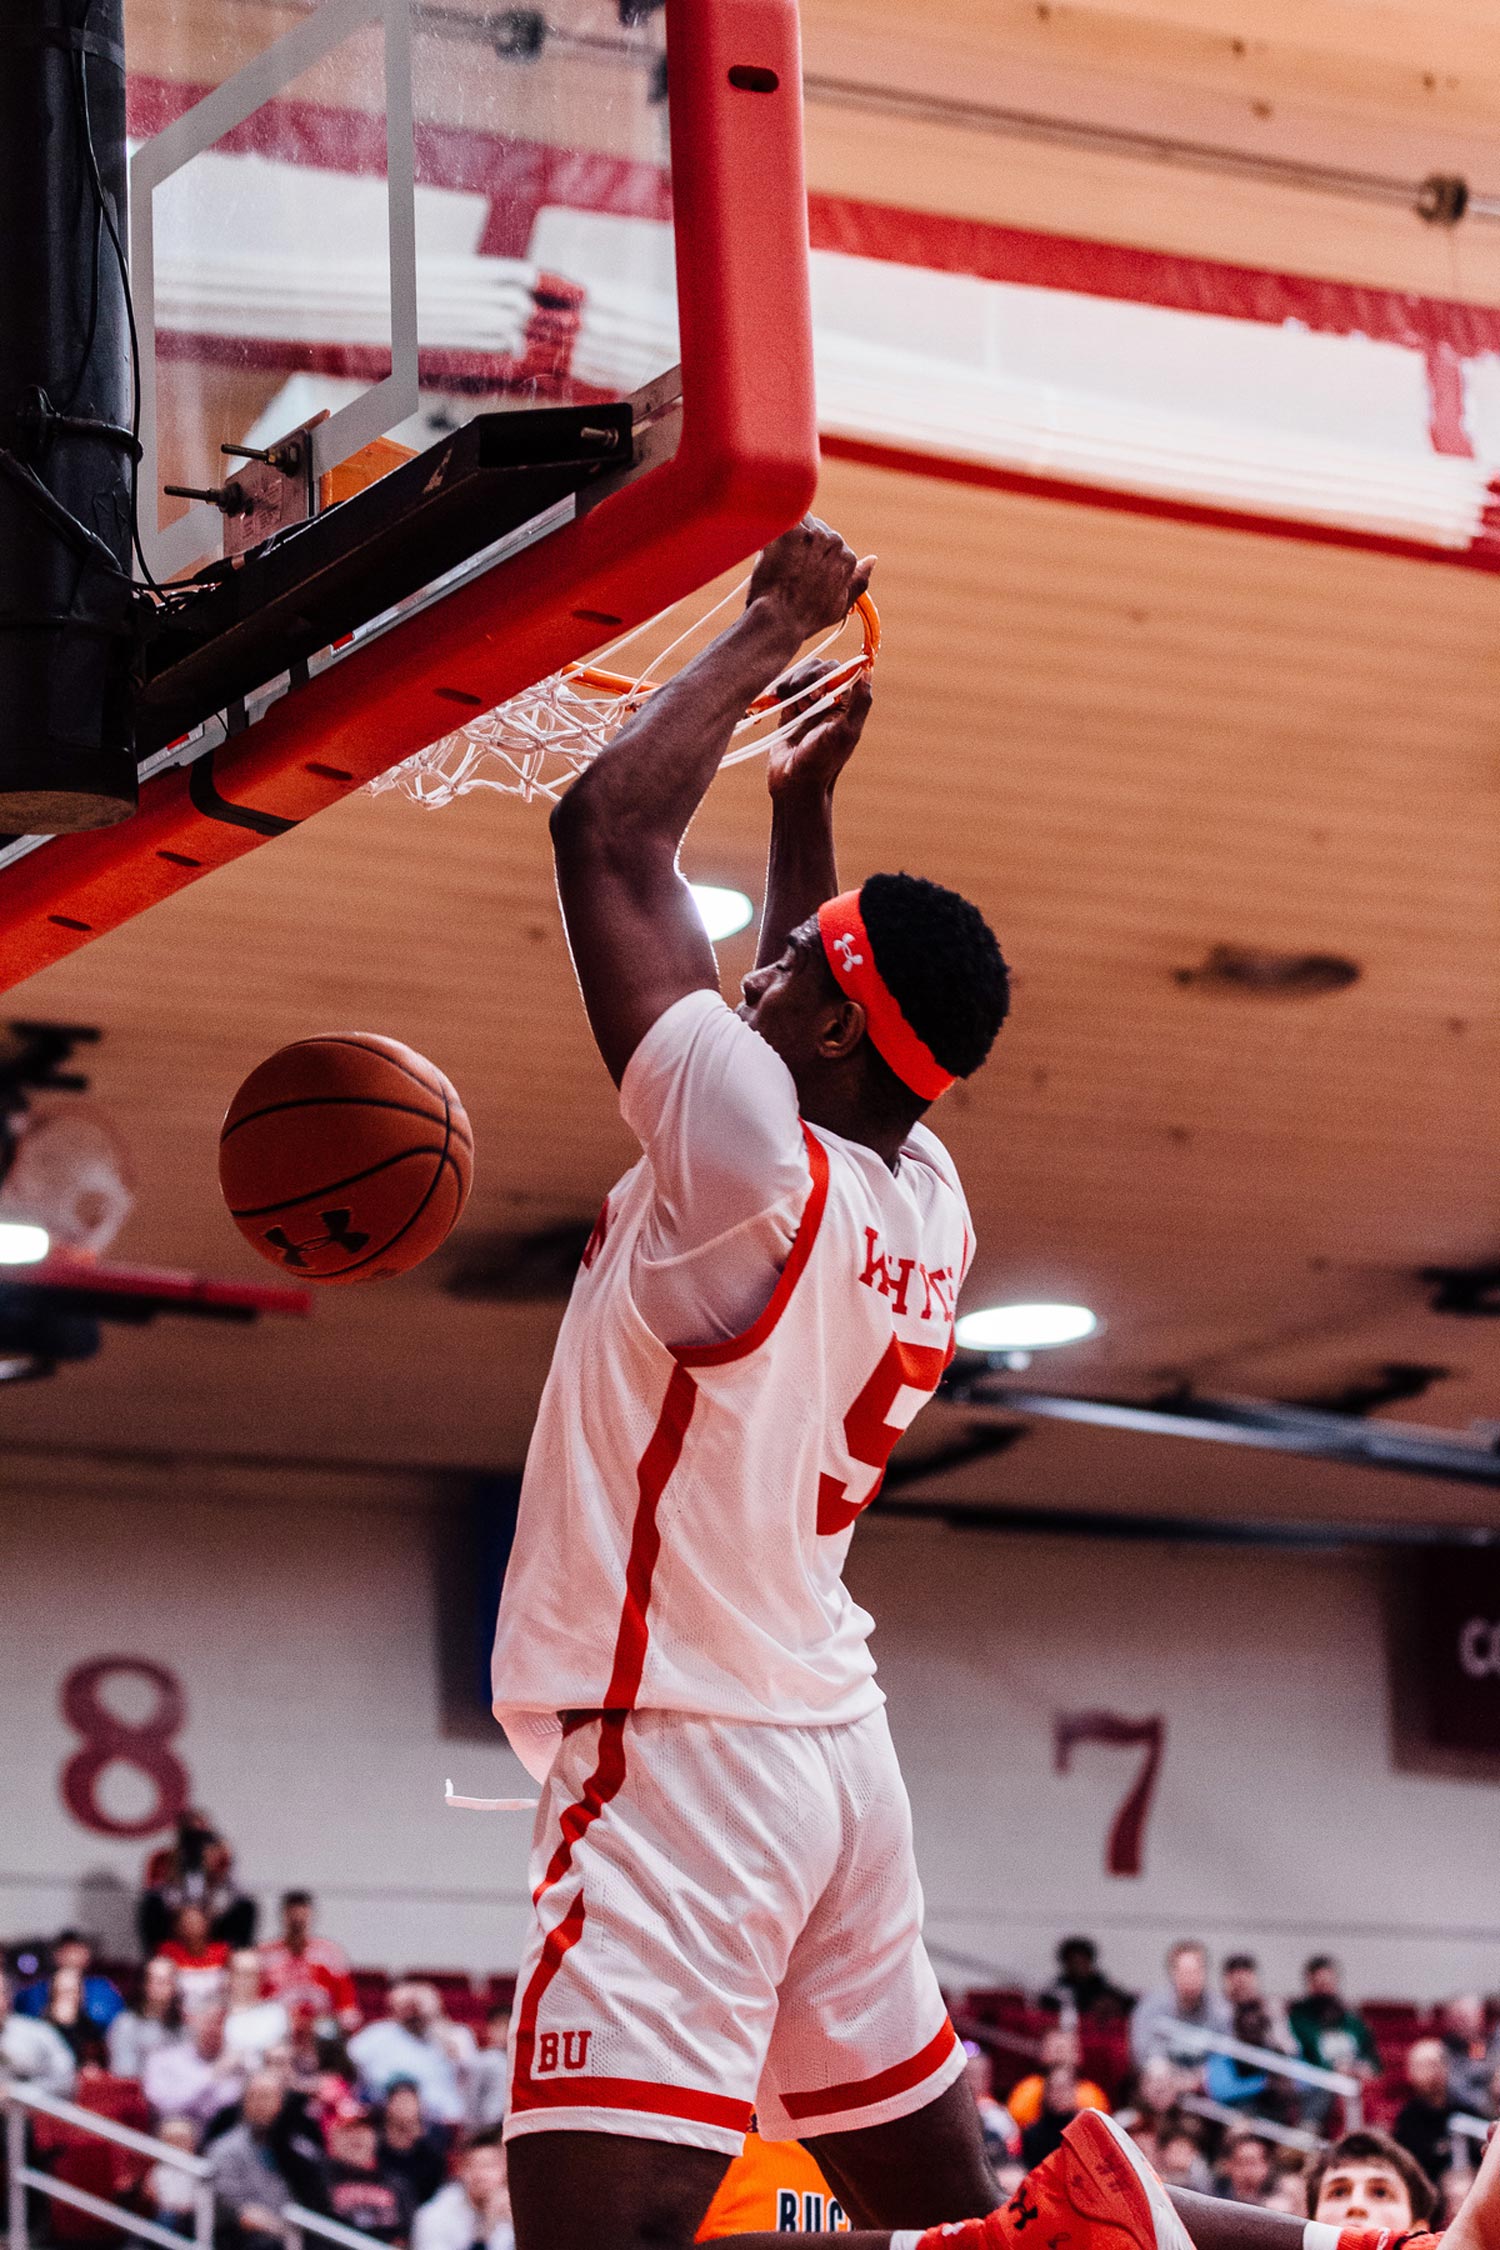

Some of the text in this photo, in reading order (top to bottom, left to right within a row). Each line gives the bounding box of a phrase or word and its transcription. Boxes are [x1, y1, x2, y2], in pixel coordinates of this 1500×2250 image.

[816, 1331, 946, 1536] 5
[60, 1656, 190, 1840] 8
[1055, 1709, 1165, 1878] 7
[538, 2030, 592, 2073] BU
